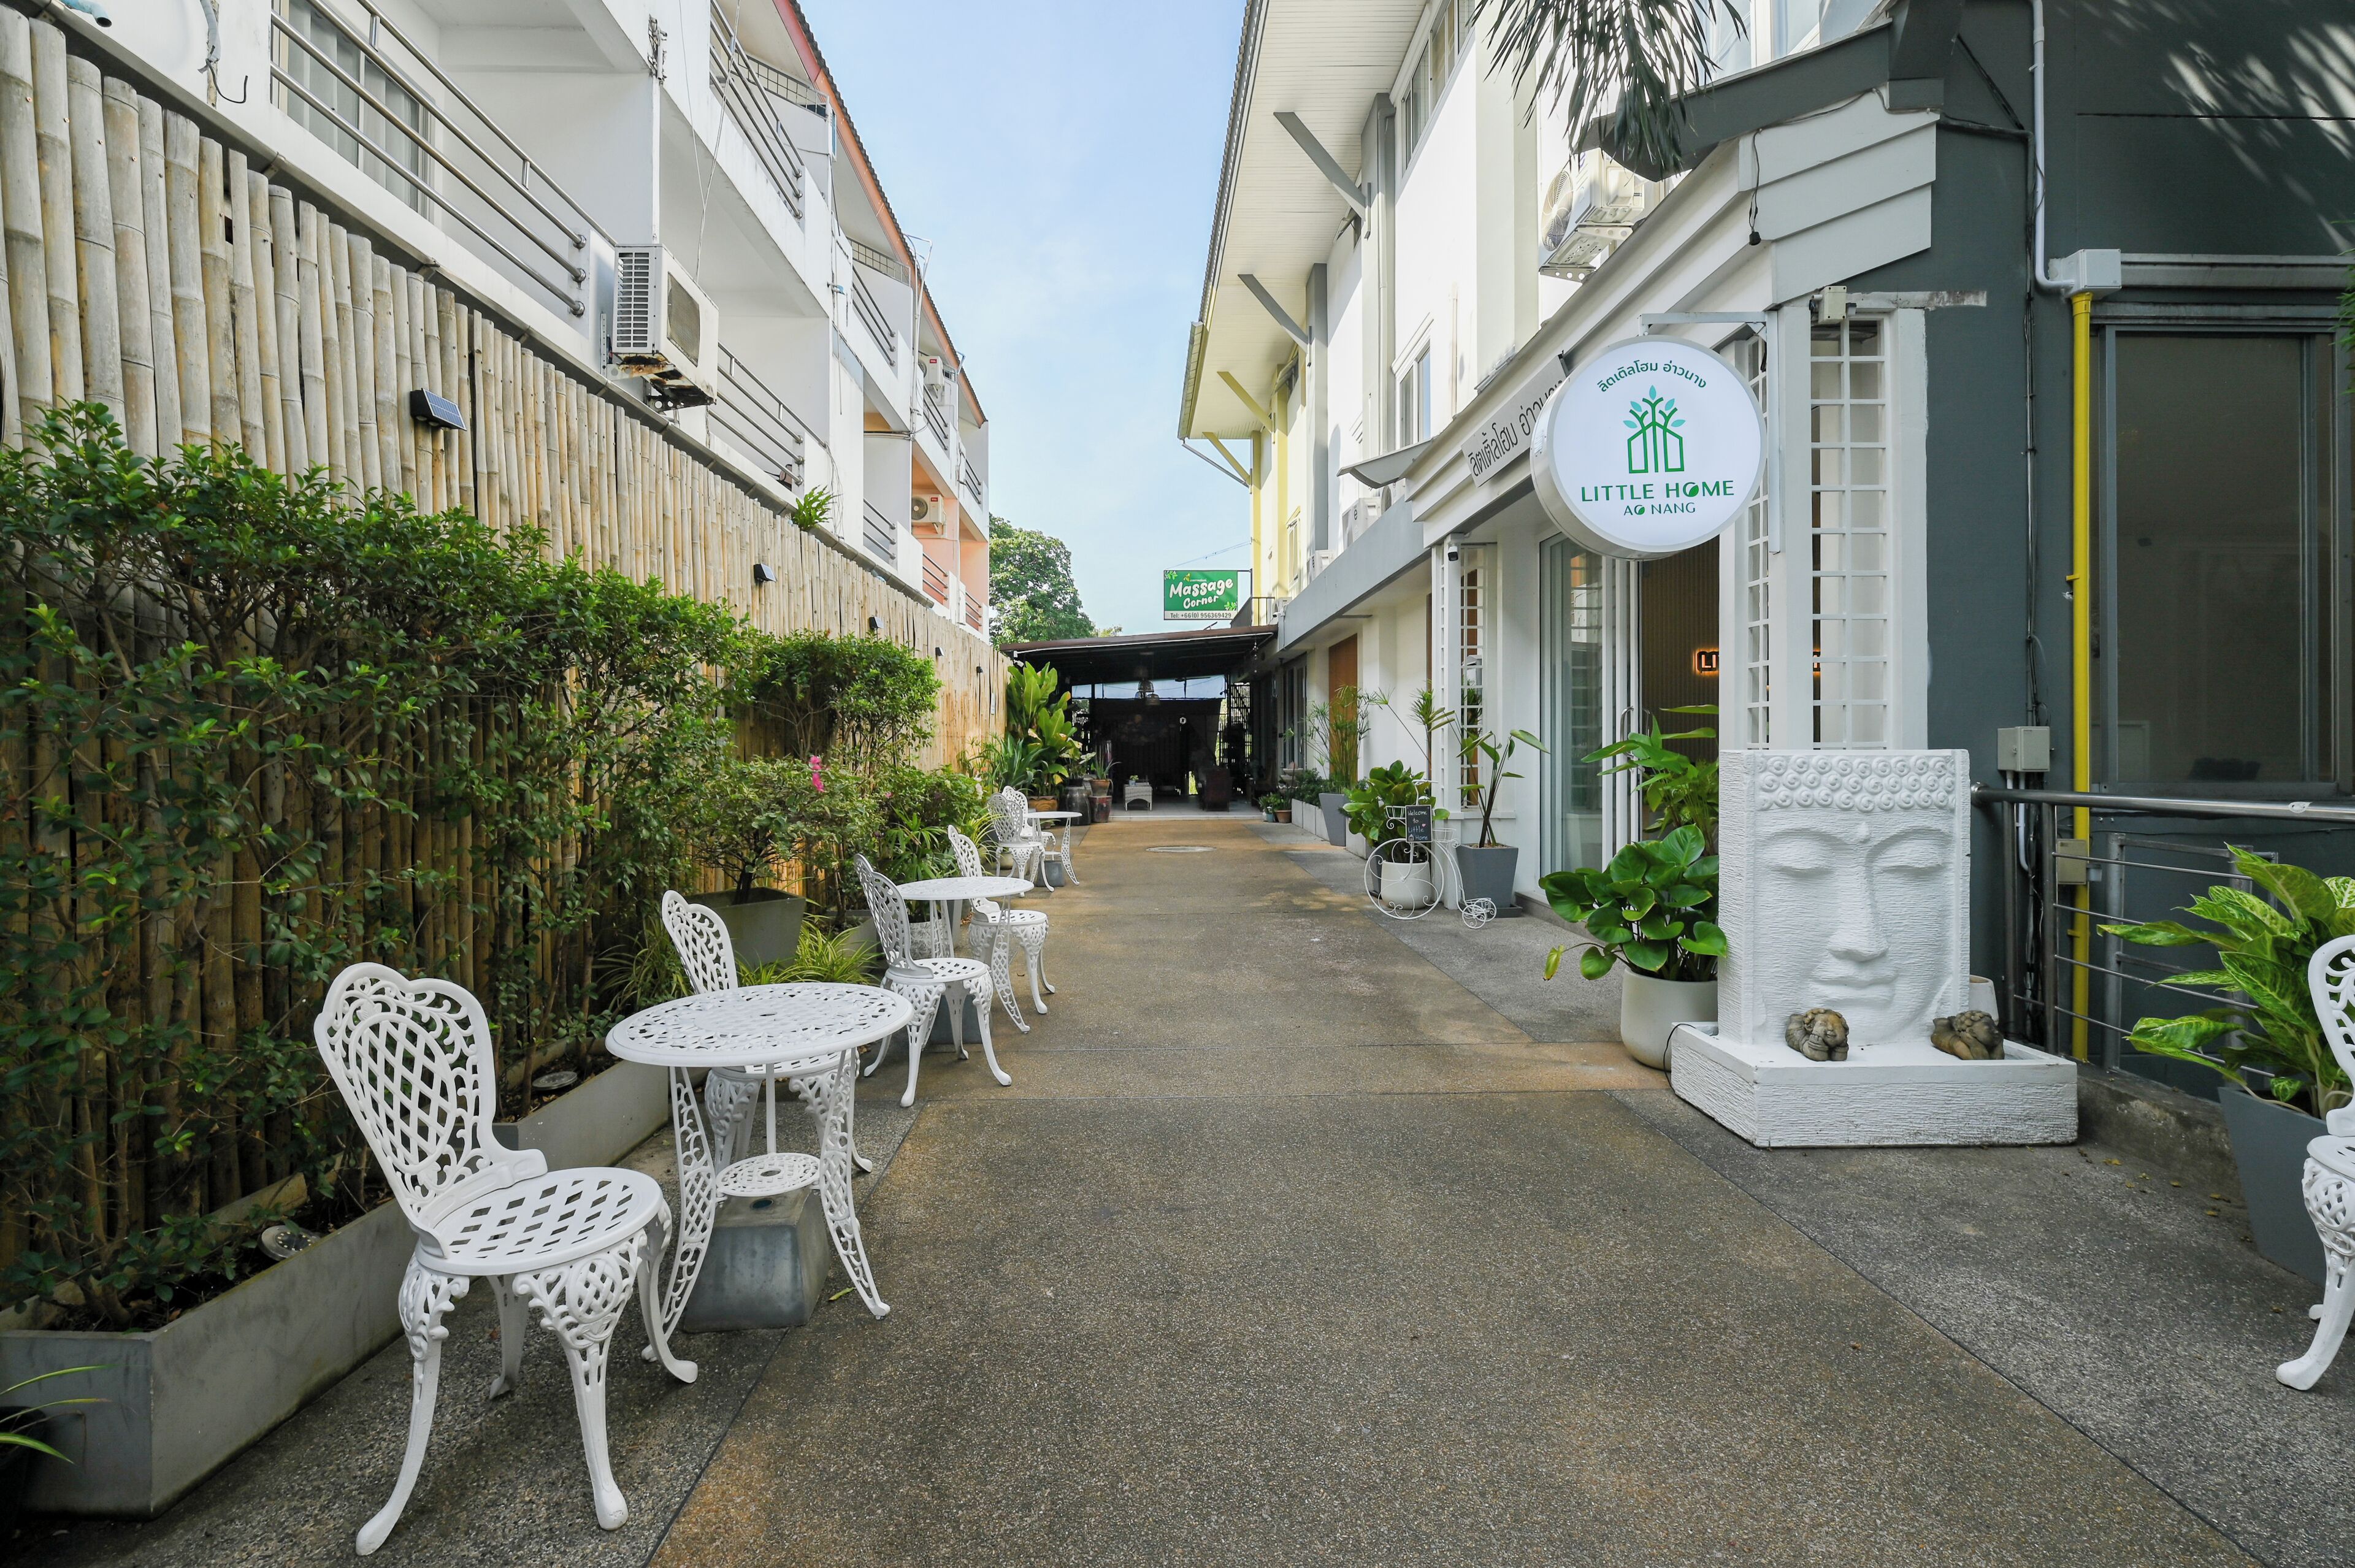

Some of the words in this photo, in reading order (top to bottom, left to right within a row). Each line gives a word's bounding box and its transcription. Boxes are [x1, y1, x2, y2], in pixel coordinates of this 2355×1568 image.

[1663, 360, 1707, 388] อ่าวนาง
[1581, 483, 1655, 502] LITTLE
[1665, 480, 1734, 499] HOME
[1623, 504, 1645, 516] AO
[1651, 502, 1696, 515] NANG
[1169, 578, 1234, 599] Massage
[1183, 595, 1219, 609] Corner
